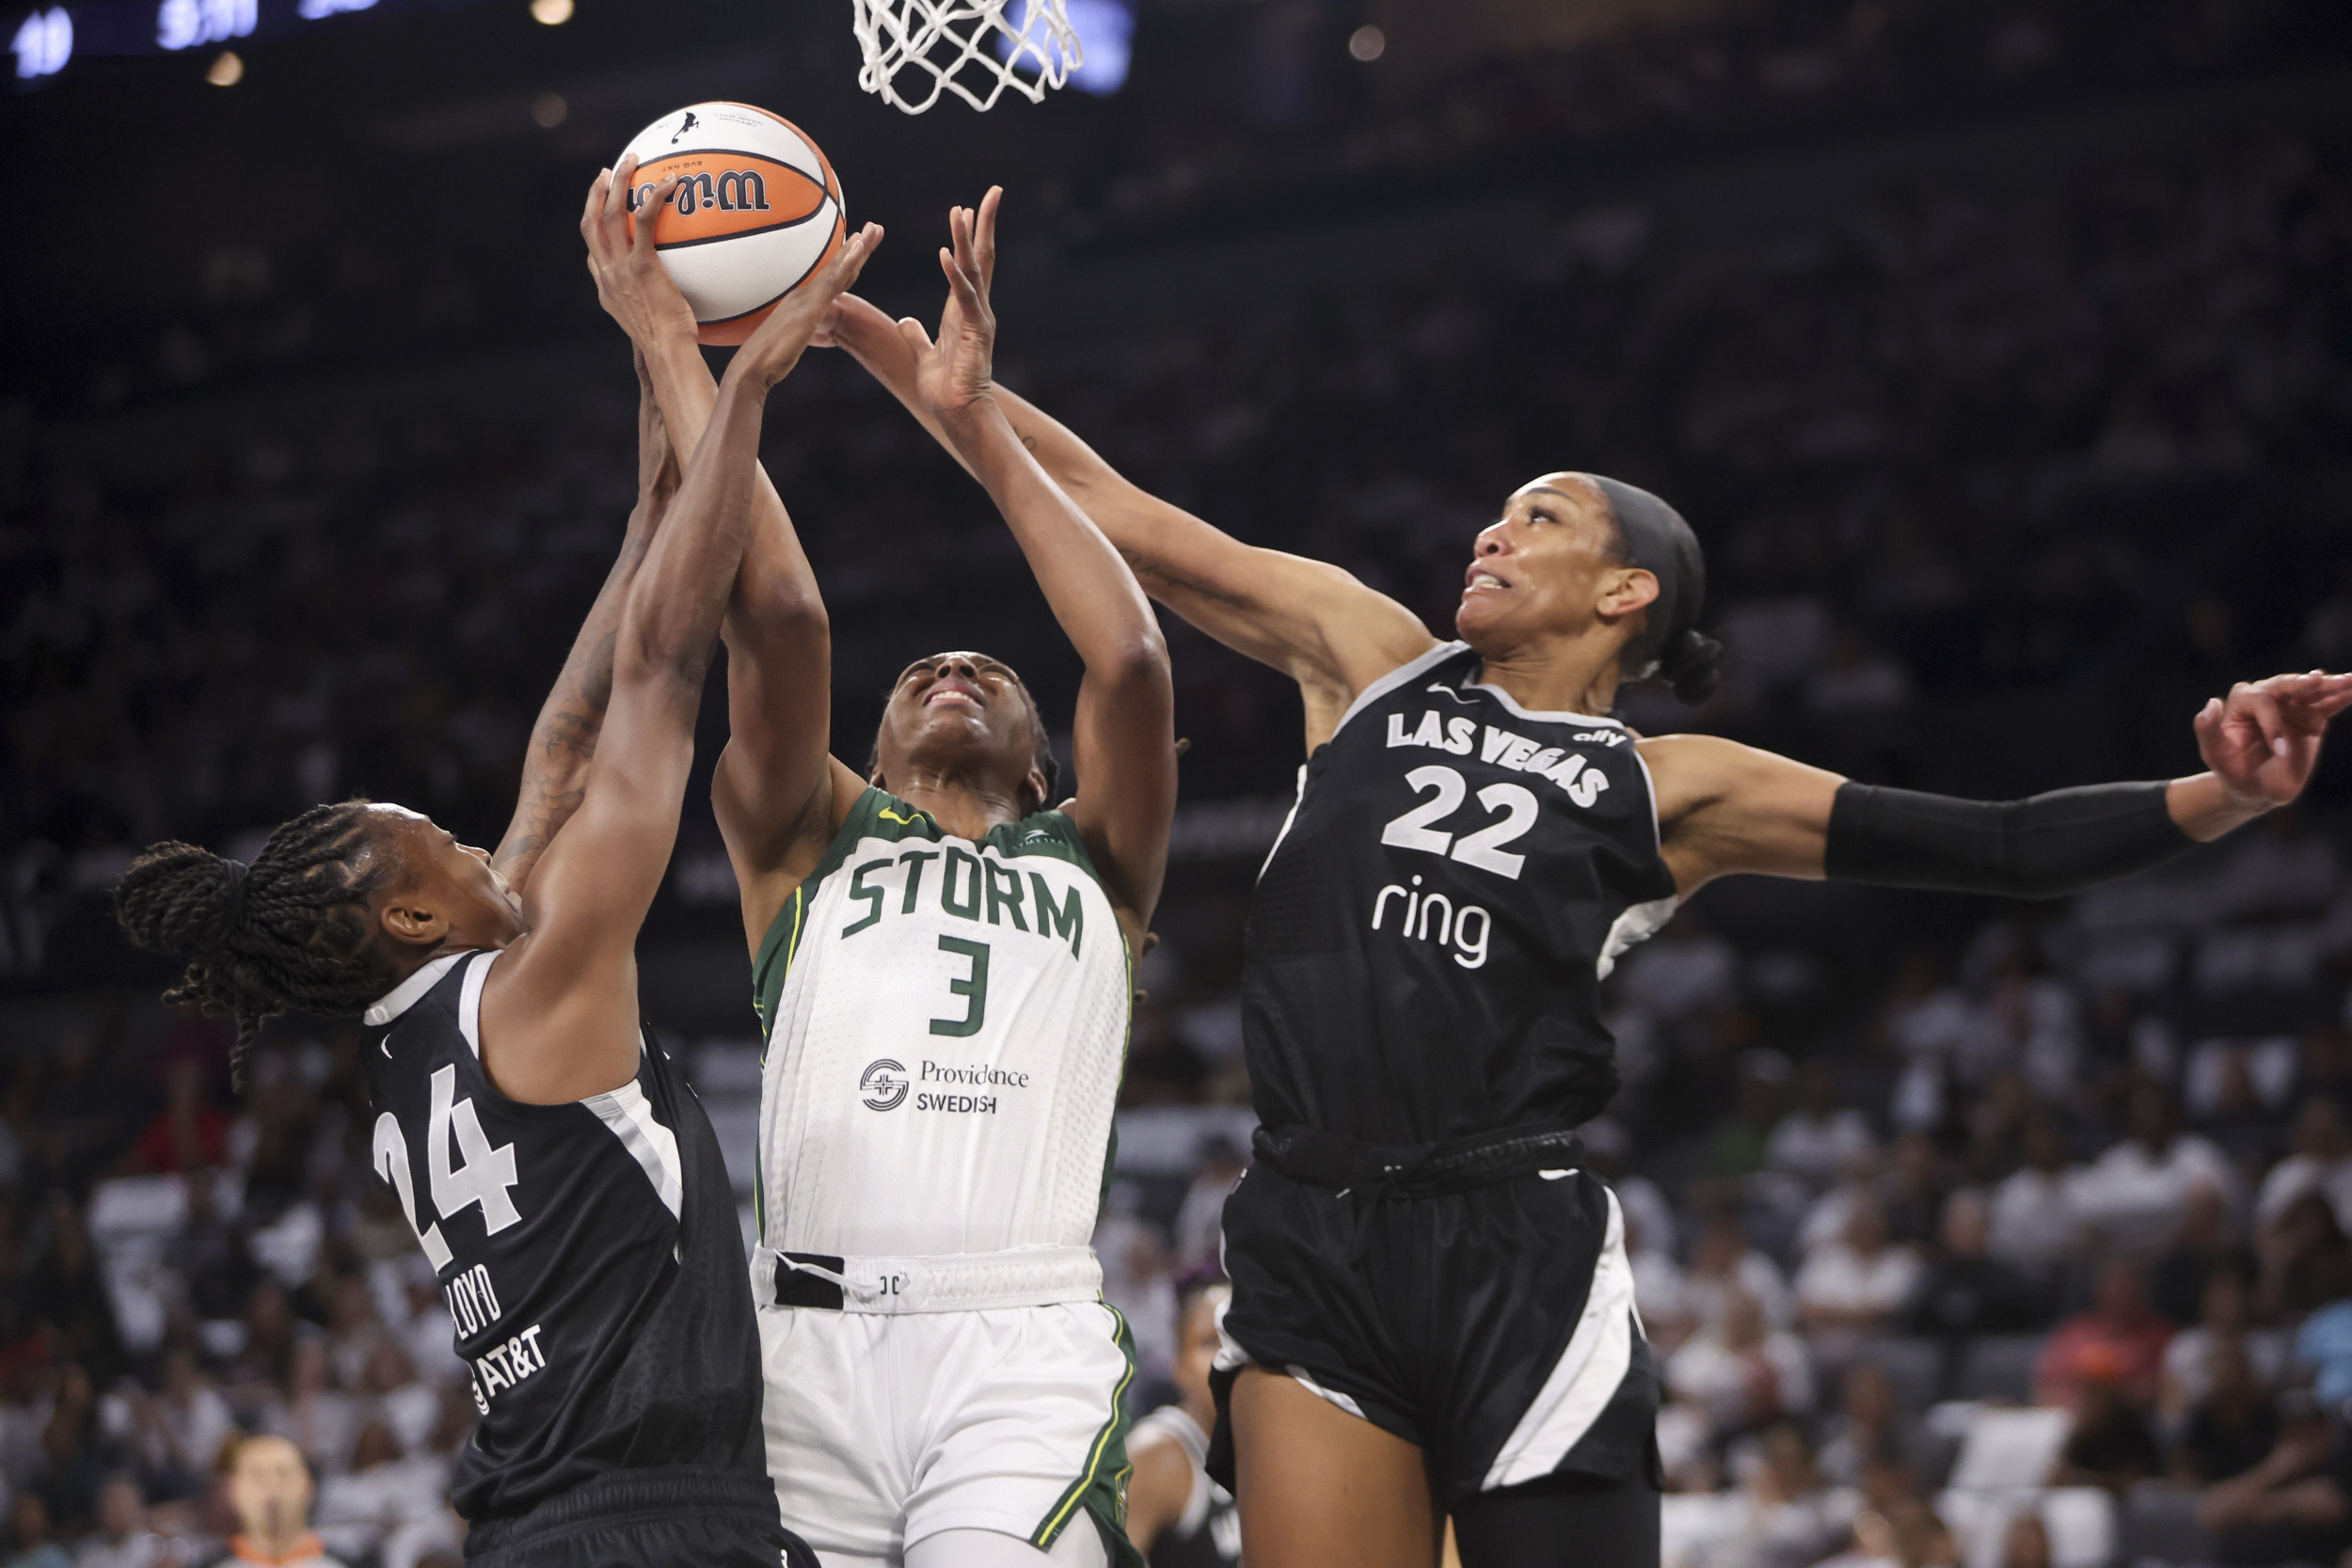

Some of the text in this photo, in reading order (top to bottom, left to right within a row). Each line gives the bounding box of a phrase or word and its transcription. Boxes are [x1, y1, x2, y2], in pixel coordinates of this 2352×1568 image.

[1386, 709, 1610, 808] LAS VEGAS
[1572, 729, 1628, 747] ally
[1380, 765, 1539, 880] 22
[840, 846, 1083, 961] STORM
[1371, 874, 1491, 970] ring
[930, 934, 991, 1037] 3
[918, 1060, 1029, 1088] Providence
[373, 1063, 522, 1276] 24
[445, 1263, 501, 1340] LOYD
[476, 1323, 547, 1397] AT&T
